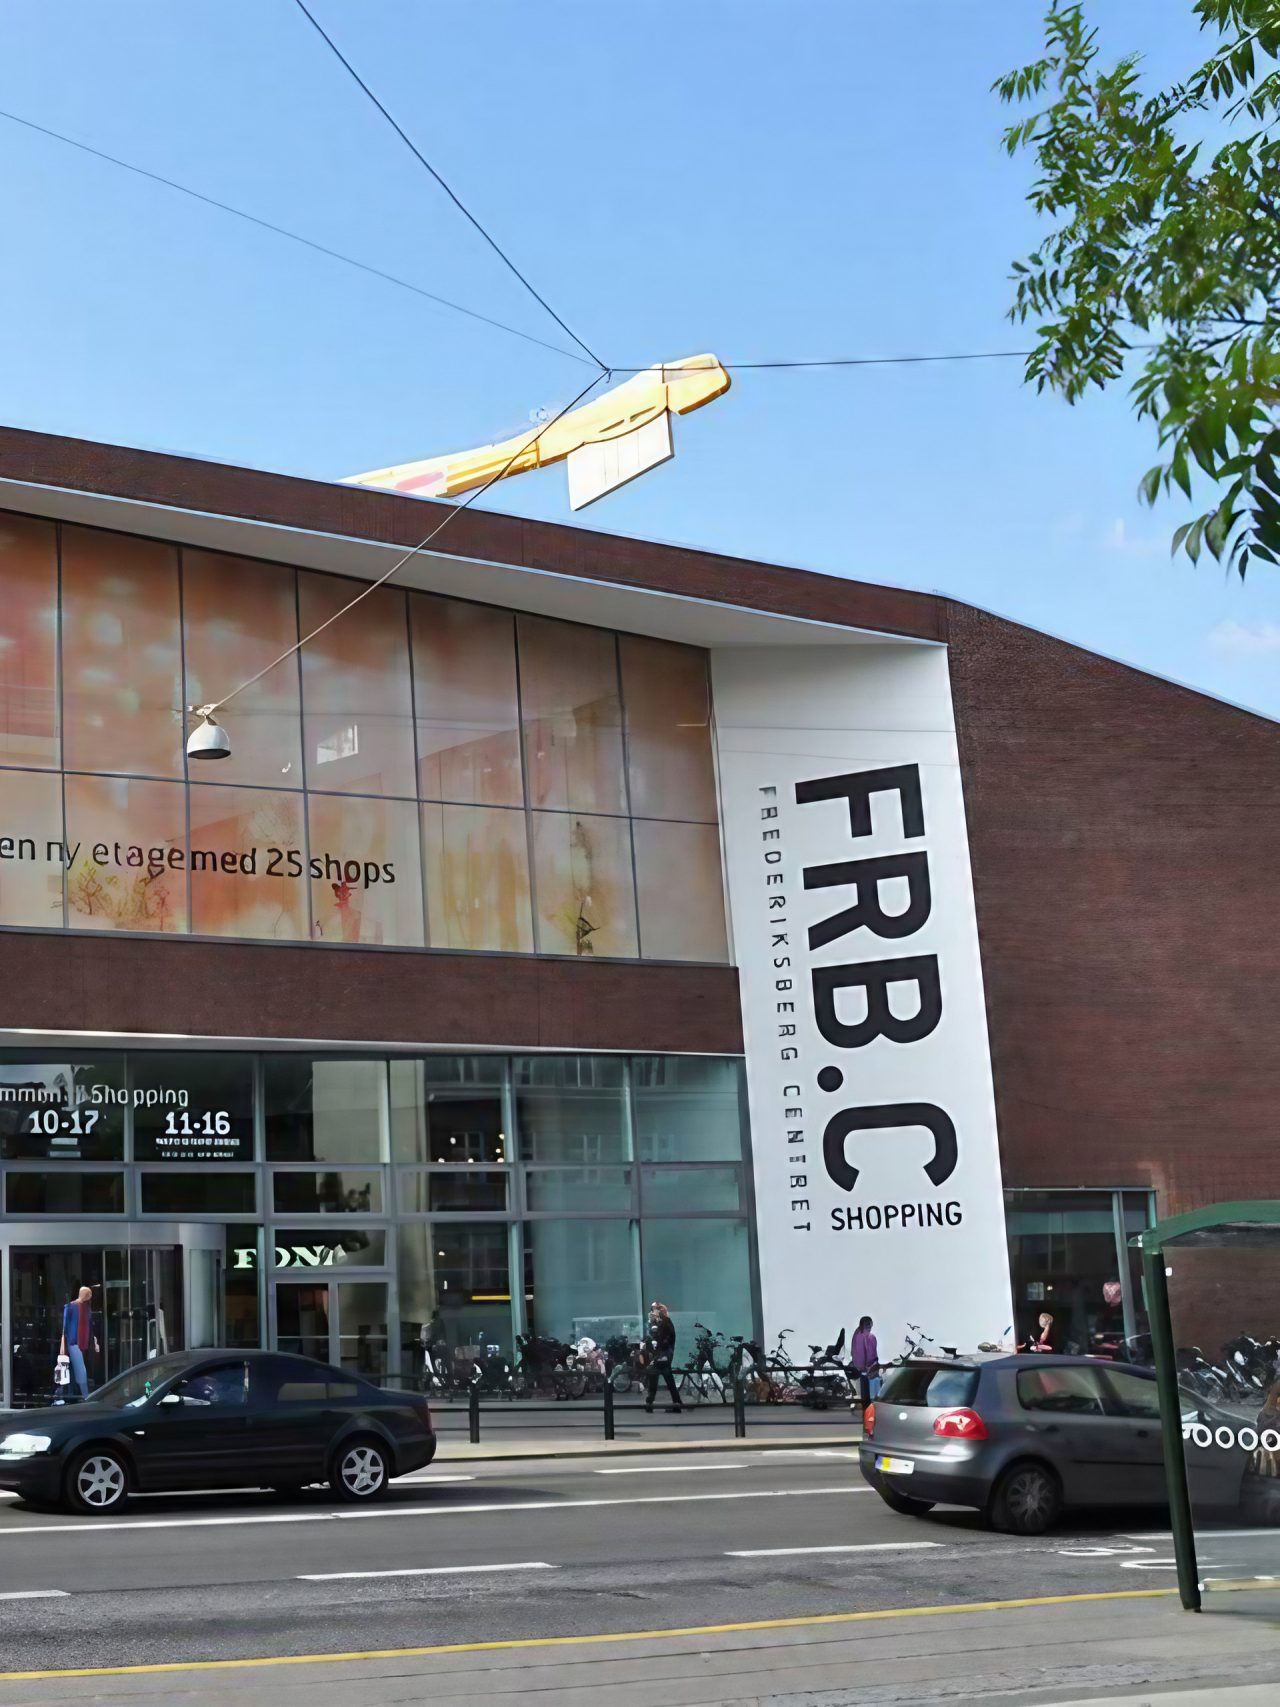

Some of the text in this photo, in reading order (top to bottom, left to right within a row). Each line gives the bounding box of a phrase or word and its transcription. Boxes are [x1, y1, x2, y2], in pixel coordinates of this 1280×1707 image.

[46, 841, 81, 870] ny
[92, 841, 185, 879] etage
[191, 848, 257, 875] med
[309, 853, 396, 889] shops
[758, 786, 798, 1060] FREDERIKSBERG
[795, 763, 958, 1192] FRB.C
[831, 1201, 963, 1231] SHOPPING
